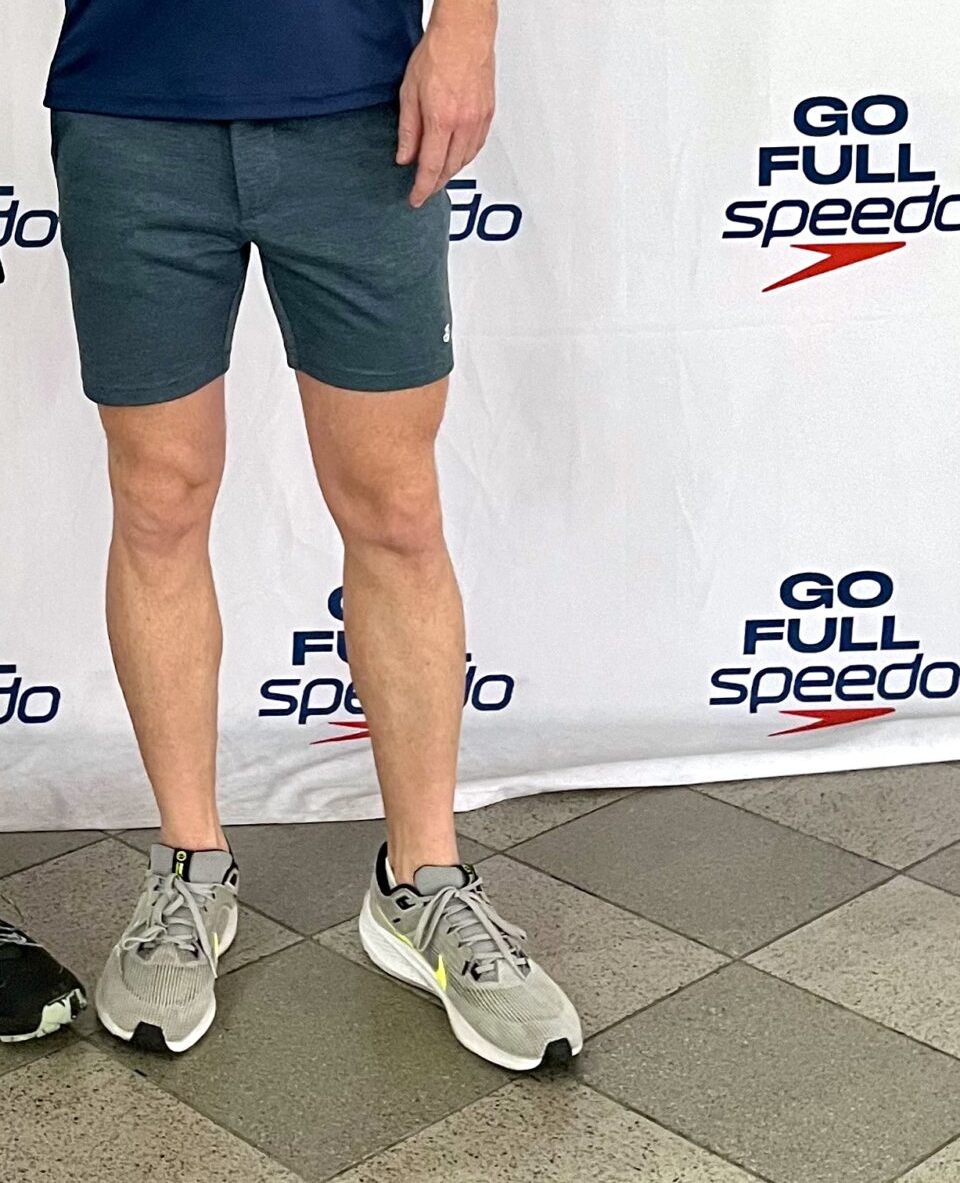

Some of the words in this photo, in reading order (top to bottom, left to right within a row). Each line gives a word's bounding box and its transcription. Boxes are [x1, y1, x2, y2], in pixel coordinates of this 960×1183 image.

[793, 94, 909, 138] GO
[758, 142, 936, 187] FULL
[779, 570, 894, 611] GO
[742, 615, 920, 655] FULL
[709, 652, 960, 714] speedo
